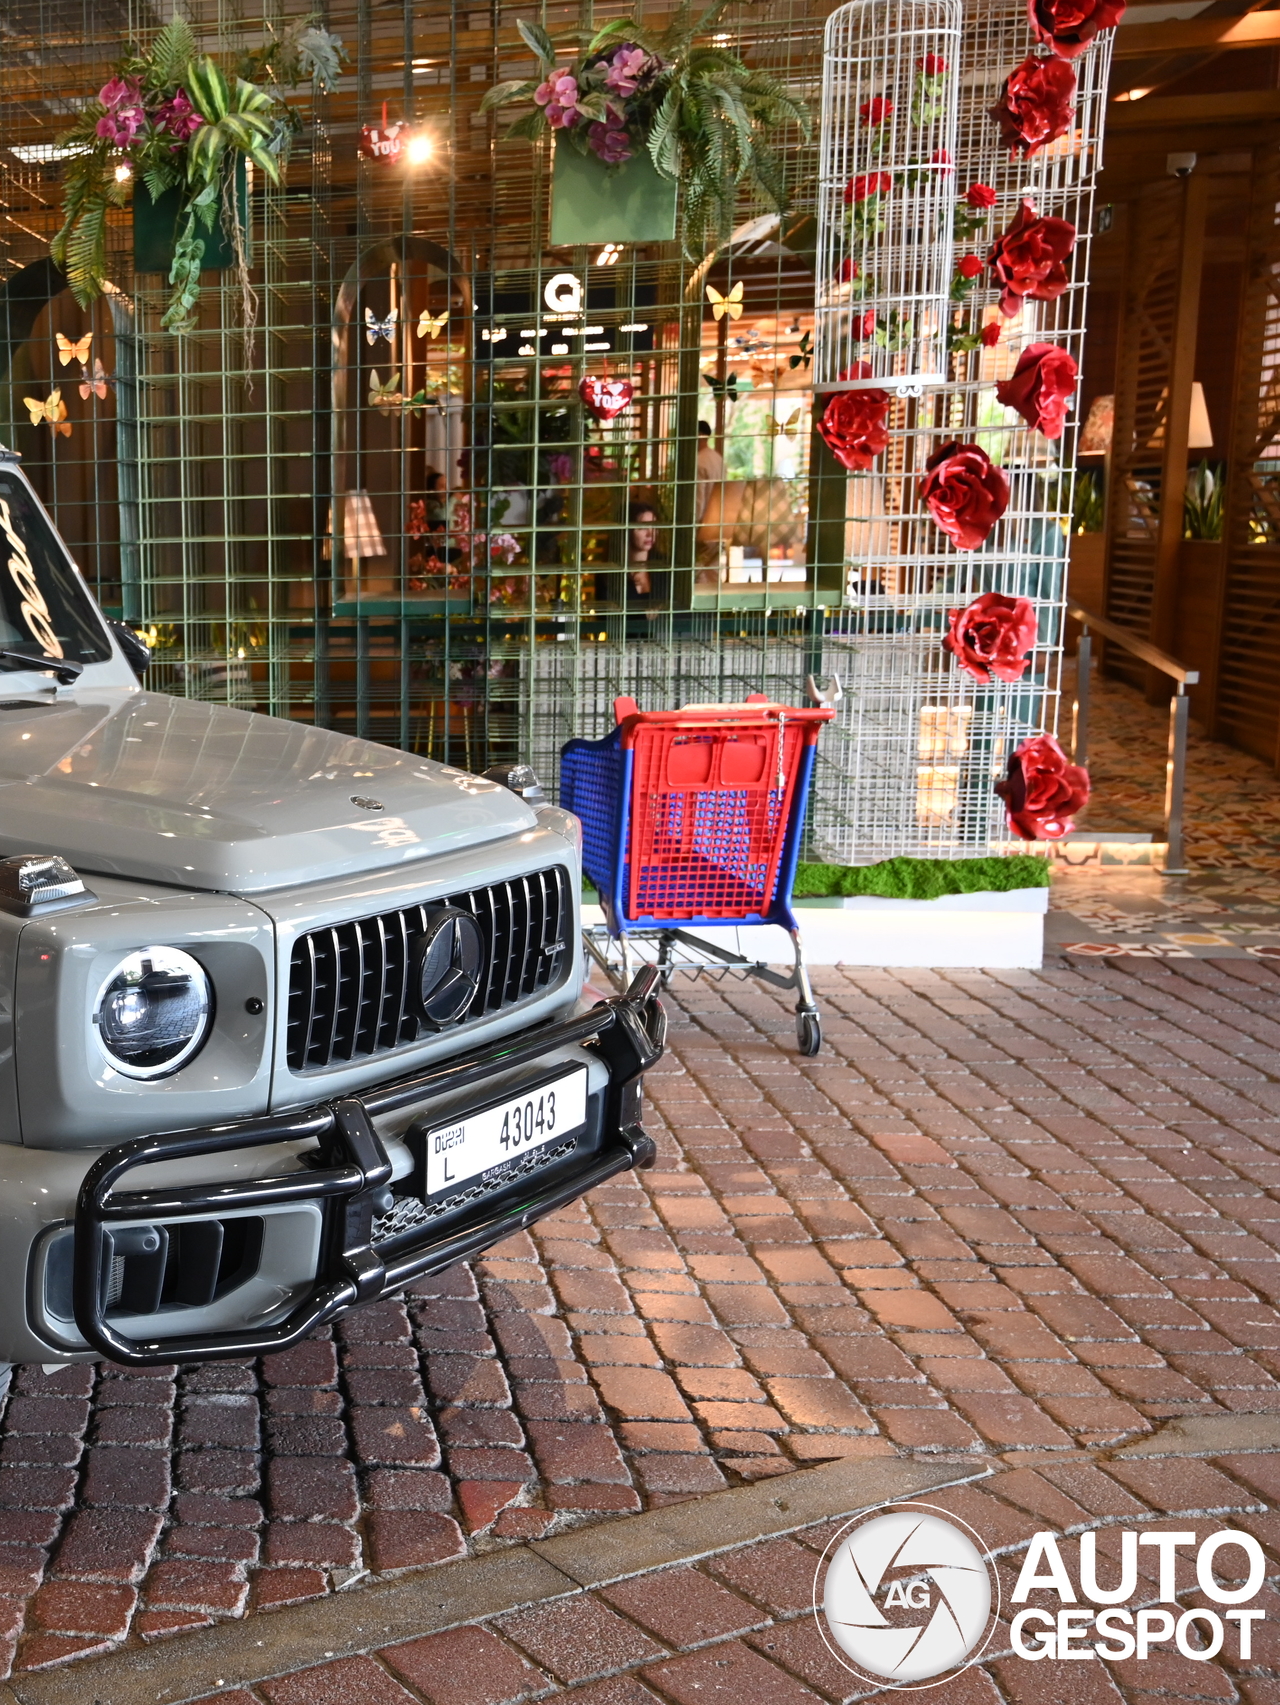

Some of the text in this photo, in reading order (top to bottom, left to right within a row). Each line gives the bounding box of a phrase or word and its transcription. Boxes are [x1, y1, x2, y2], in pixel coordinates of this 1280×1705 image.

[371, 139, 401, 157] YOU
[499, 1091, 556, 1151] 43043
[443, 1156, 456, 1183] L
